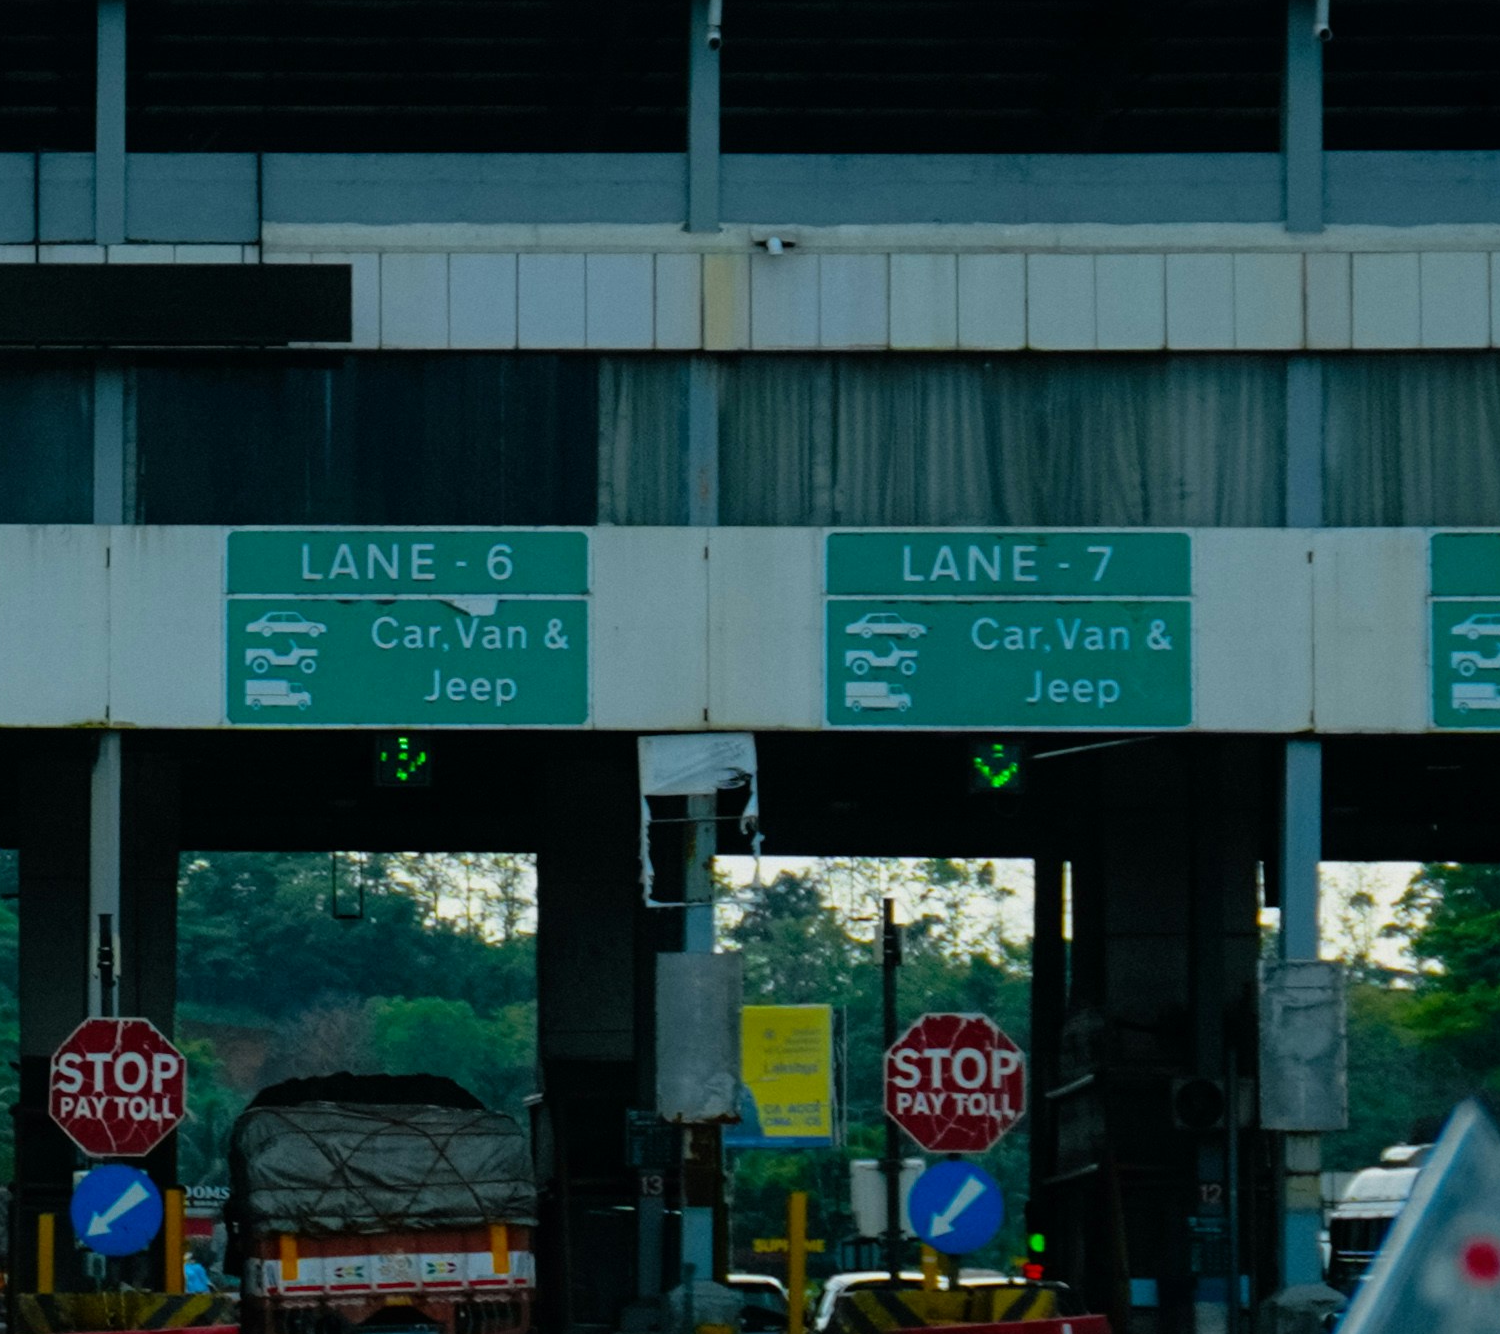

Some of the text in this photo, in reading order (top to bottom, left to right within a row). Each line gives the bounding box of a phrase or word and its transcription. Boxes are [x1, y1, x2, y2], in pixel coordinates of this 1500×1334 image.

[301, 543, 435, 580] LANE
[486, 544, 513, 581] 6
[903, 544, 1038, 582] LANE
[1087, 546, 1113, 582] 7
[544, 618, 569, 649] &
[1146, 619, 1173, 651] &
[423, 669, 517, 707] Jeep
[1025, 670, 1121, 708] Jeep
[59, 1052, 179, 1093] STOP
[893, 1047, 1018, 1089] STOP
[60, 1096, 176, 1121] PAY TOLL
[896, 1092, 1016, 1118] PAY TOLL
[642, 1175, 664, 1195] 13
[1200, 1184, 1222, 1203] 12
